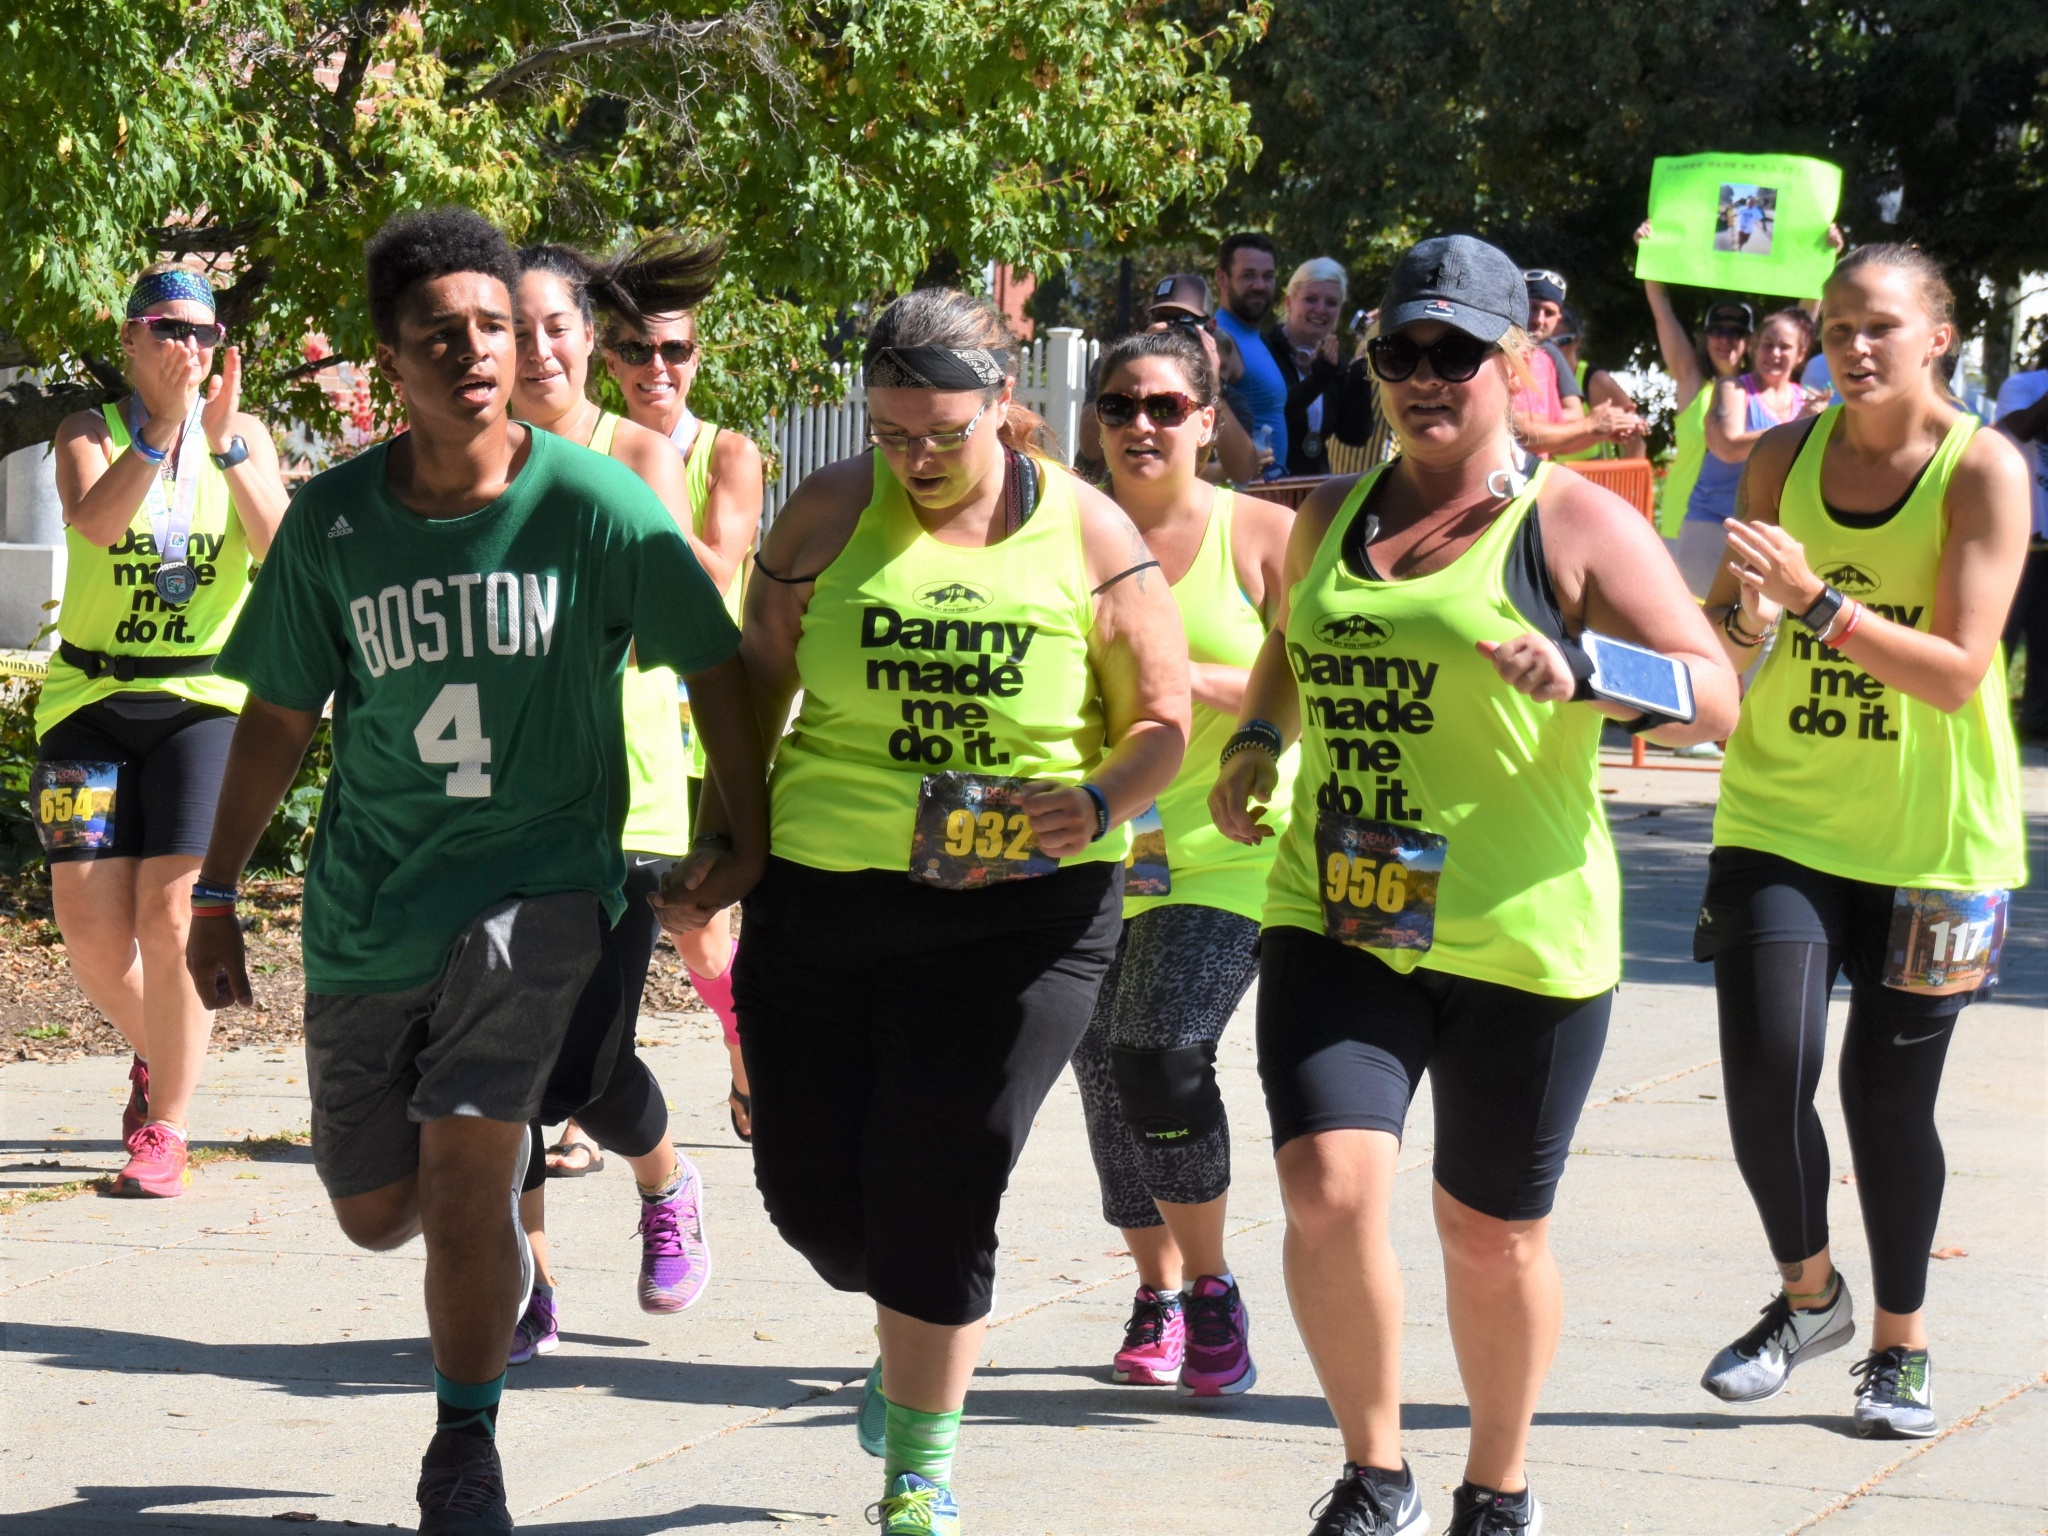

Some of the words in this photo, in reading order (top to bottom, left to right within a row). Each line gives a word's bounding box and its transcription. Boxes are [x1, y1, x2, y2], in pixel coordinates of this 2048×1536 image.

[109, 526, 225, 562] Dany
[328, 527, 354, 538] adidas
[115, 614, 157, 643] do
[162, 614, 195, 643] it.
[350, 571, 557, 678] BOSTON
[861, 607, 1038, 664] Danny
[1792, 631, 1854, 664] ma
[867, 654, 1024, 697] made
[1287, 642, 1439, 700] Danny
[1810, 668, 1885, 700] me
[902, 699, 988, 730] me
[1305, 690, 1434, 735] made
[1789, 698, 1846, 737] do
[1858, 702, 1898, 741] it.
[413, 683, 491, 797] 4
[889, 725, 953, 765] do
[962, 730, 1010, 767] it.
[1324, 737, 1401, 773] me
[41, 787, 94, 824] 654
[1317, 771, 1363, 817] do
[1374, 776, 1422, 821] it.
[945, 808, 1032, 860] 932
[1326, 852, 1408, 913] 956
[1929, 921, 1989, 962] 117
